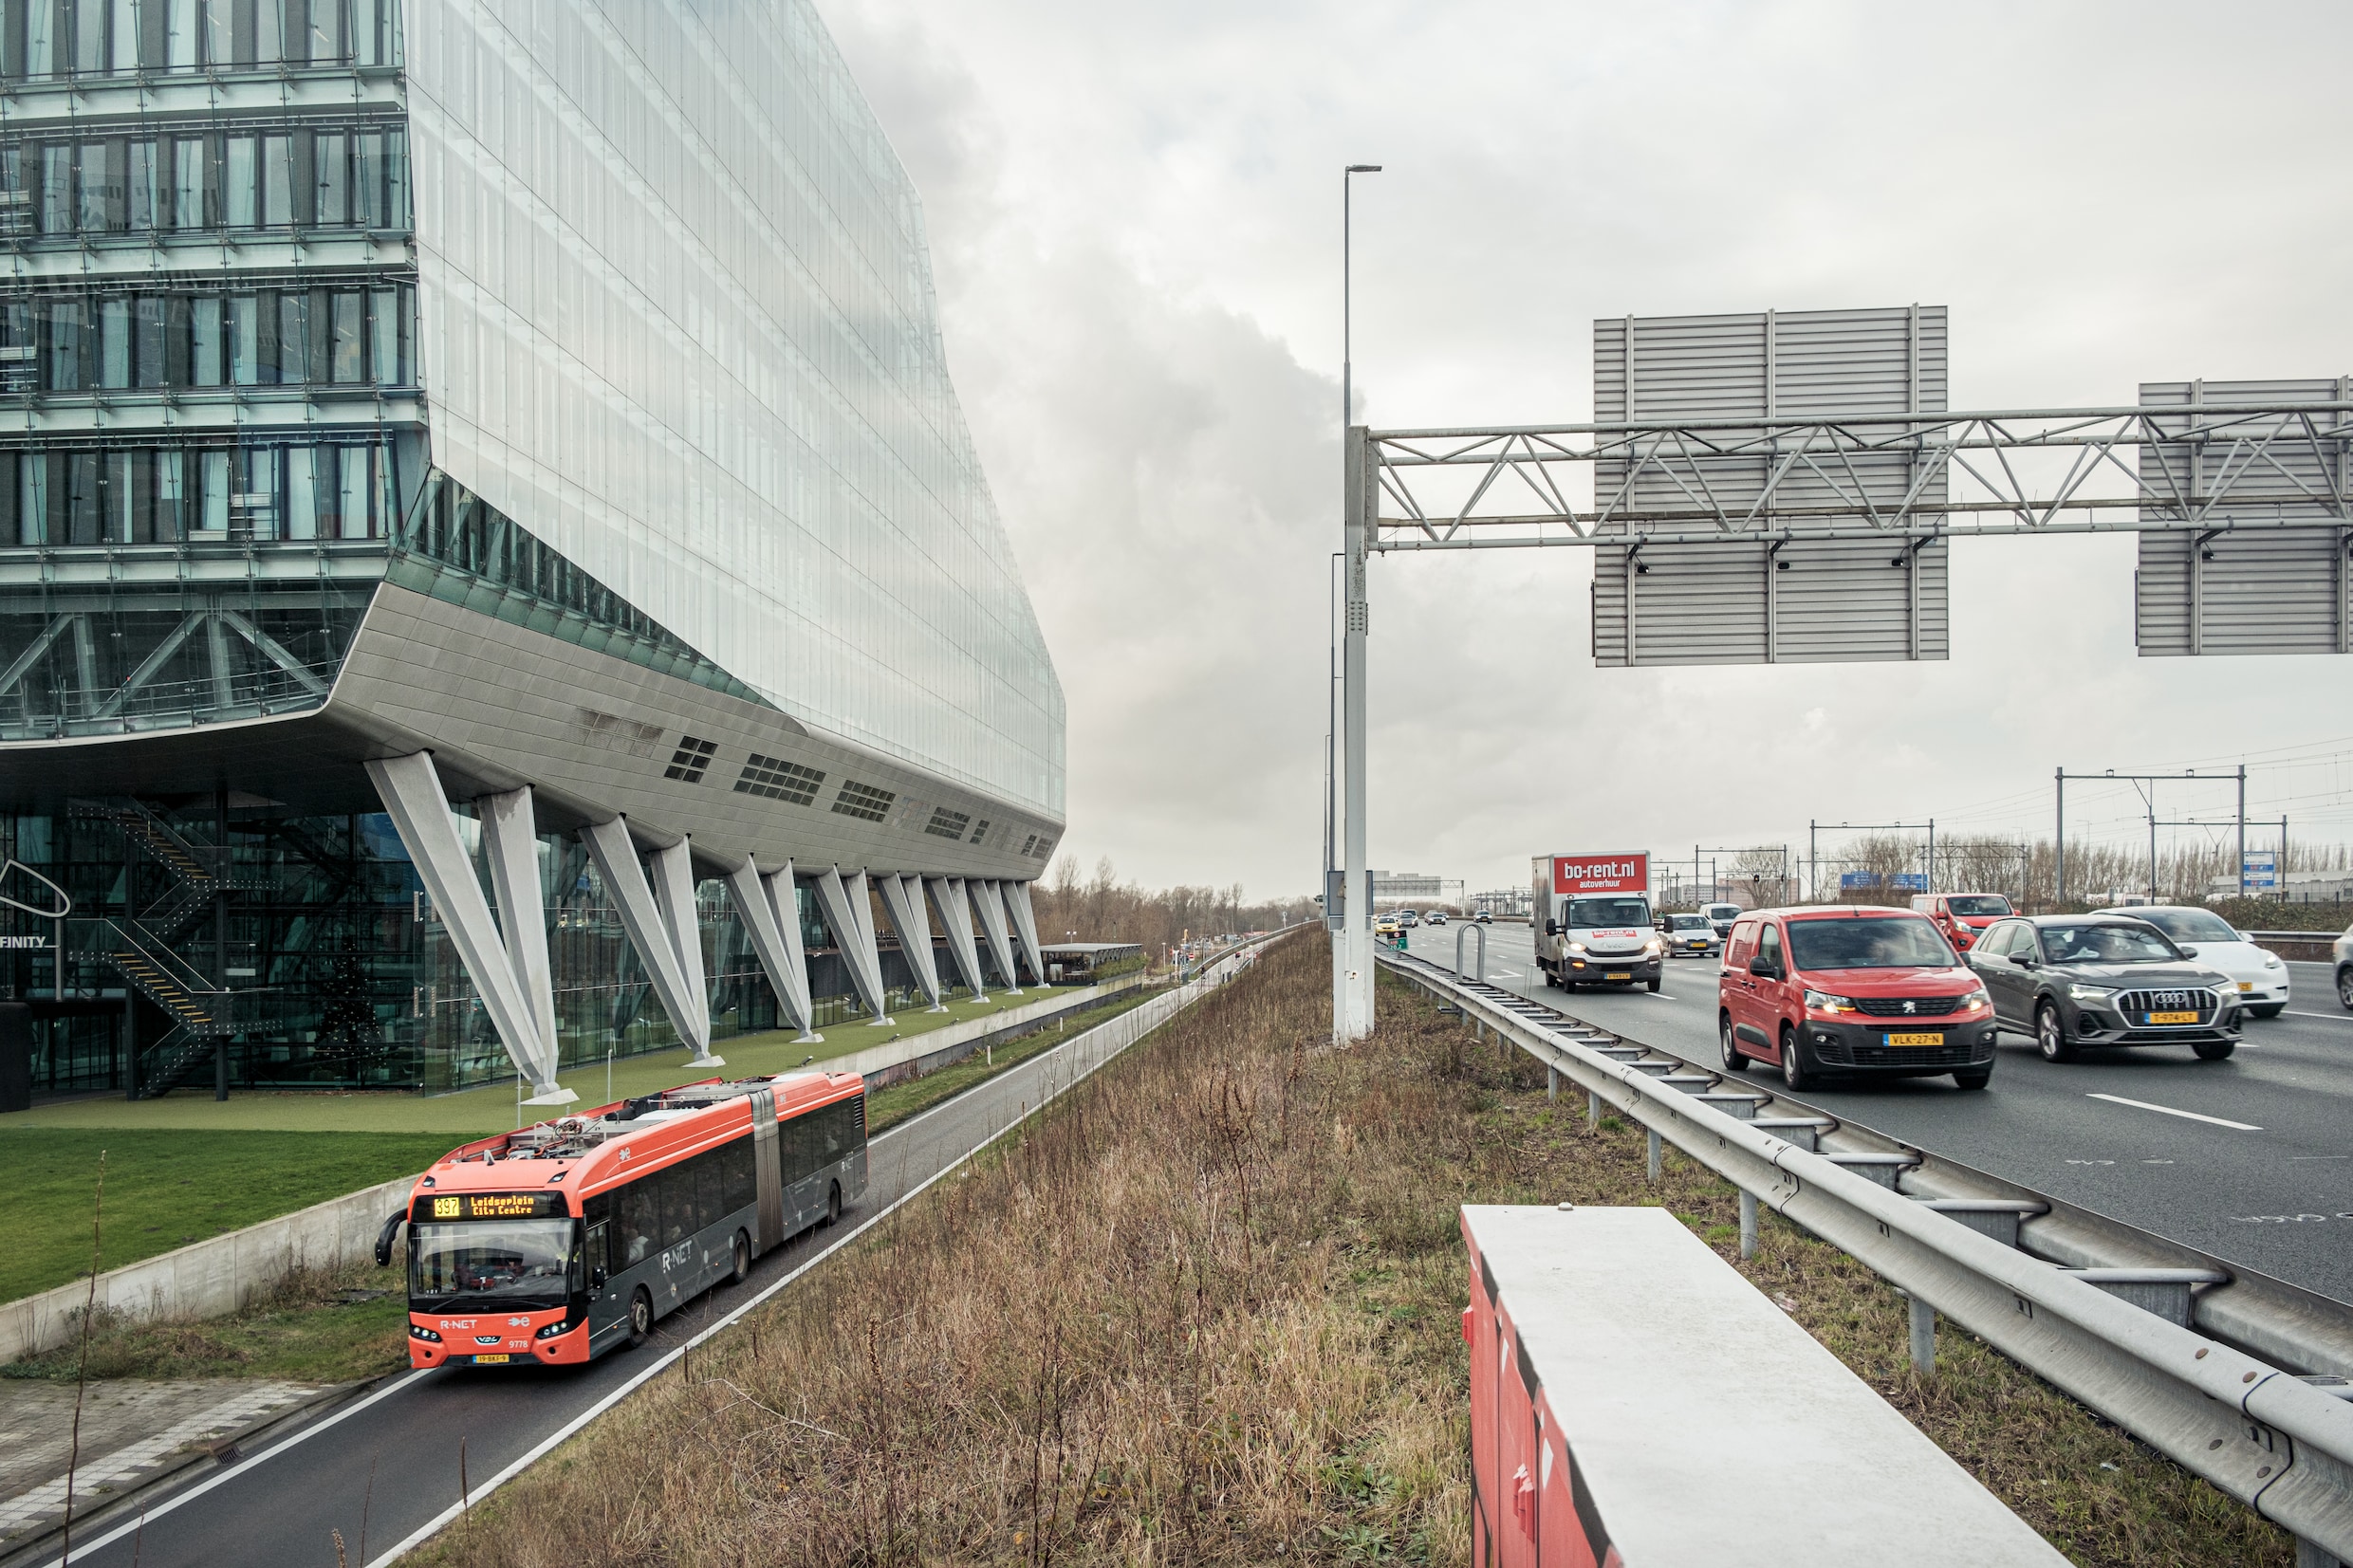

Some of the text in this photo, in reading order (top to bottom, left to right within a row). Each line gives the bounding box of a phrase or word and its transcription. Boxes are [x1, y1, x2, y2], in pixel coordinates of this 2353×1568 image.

[1564, 860, 1635, 879] bo-rent.nl
[1579, 878, 1621, 889] autoverhuur
[1892, 1035, 1939, 1043] VLK-27-N
[436, 1198, 457, 1215] 397
[471, 1195, 534, 1207] Leidseplein
[472, 1205, 532, 1216] City Centre
